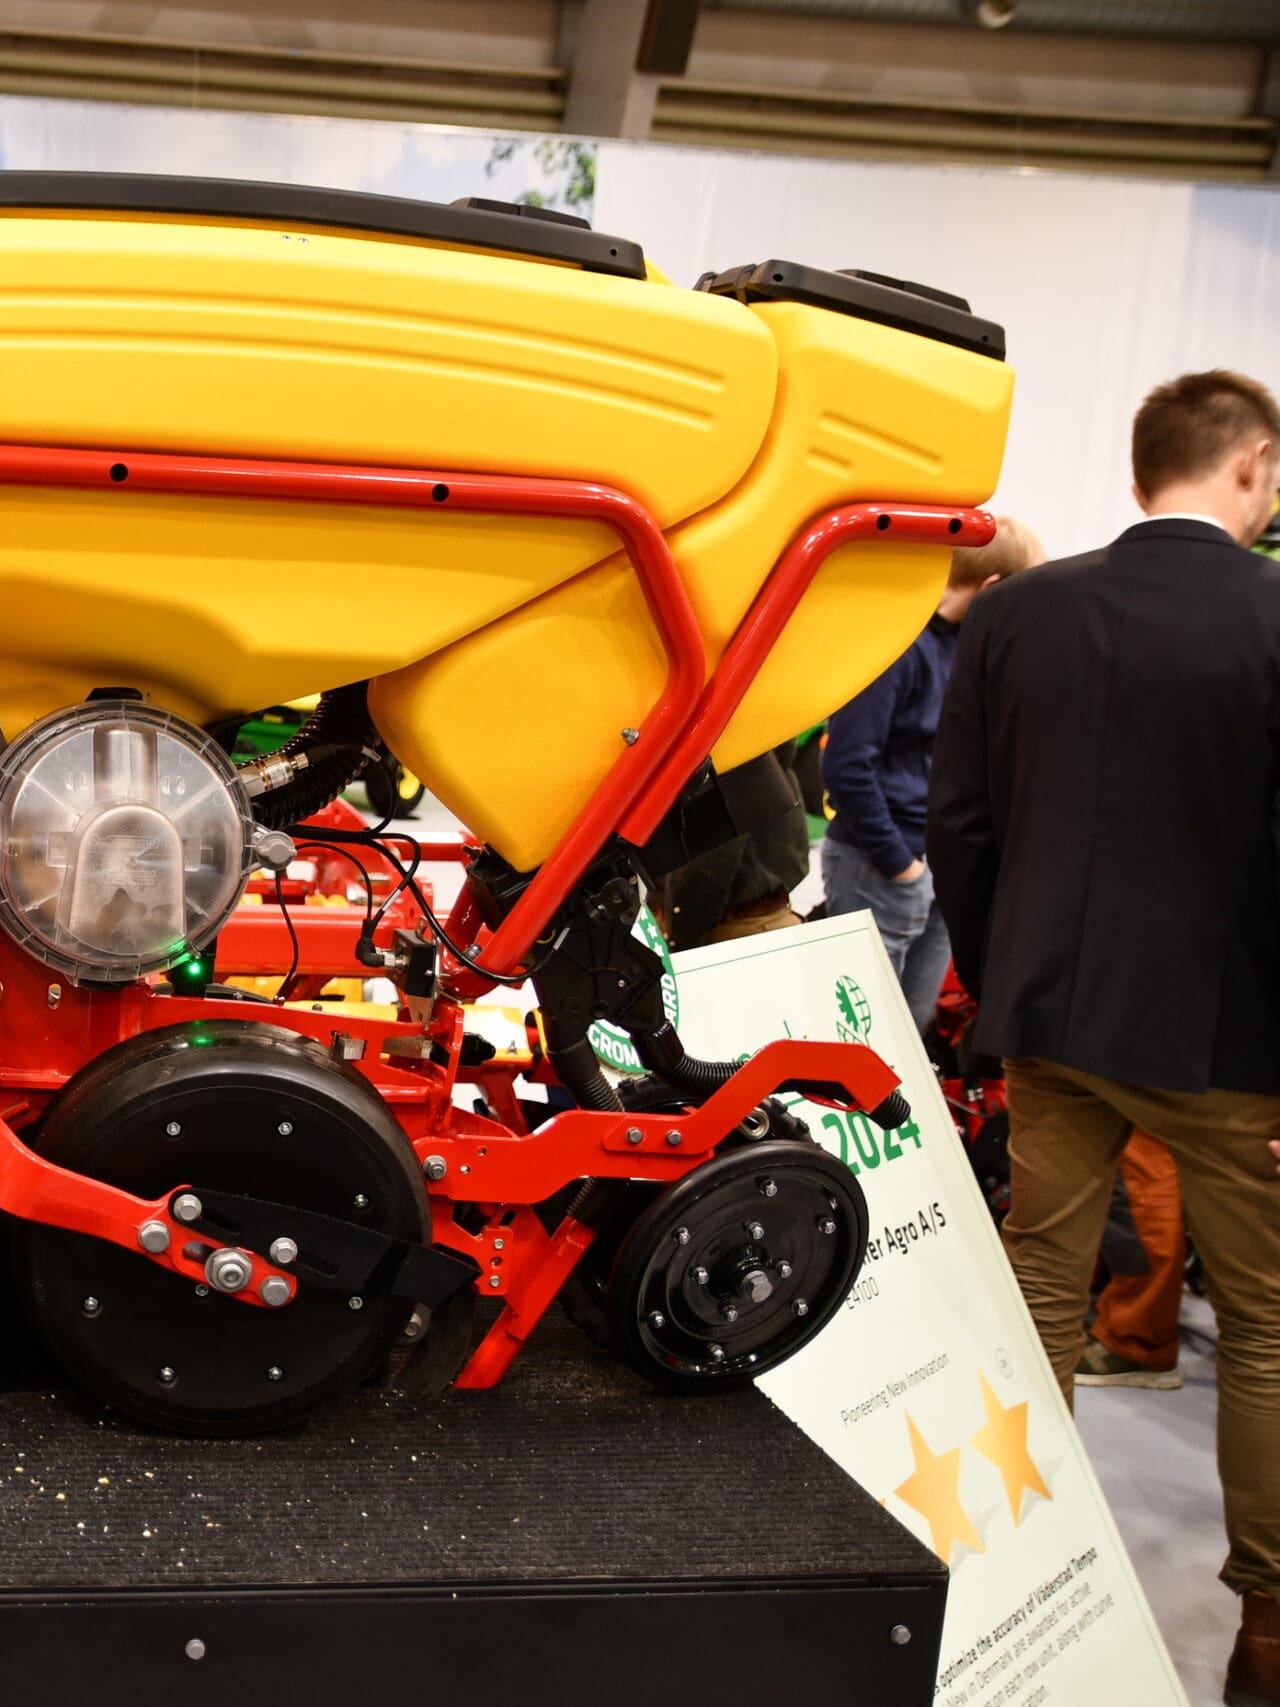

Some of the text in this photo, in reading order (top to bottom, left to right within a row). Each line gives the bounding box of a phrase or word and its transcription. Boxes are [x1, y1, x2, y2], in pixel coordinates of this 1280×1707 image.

[587, 1023, 642, 1068] GROM
[821, 1089, 922, 1176] 2024
[884, 1222, 919, 1255] Agro
[918, 1202, 946, 1236] A/S
[839, 1353, 950, 1428] Pioneering New Innovation
[939, 1648, 979, 1690] optimize
[975, 1636, 994, 1655] the
[992, 1607, 1028, 1643] accuracy
[1025, 1592, 1036, 1614] of
[1070, 1546, 1097, 1574] Tempo
[975, 1648, 1014, 1689] Denmark
[1012, 1638, 1028, 1658] are
[1025, 1609, 1059, 1646] awarded
[1056, 1598, 1070, 1618] for
[1069, 1581, 1092, 1608] active
[1004, 1672, 1024, 1698] each
[1057, 1624, 1081, 1652] along
[1078, 1608, 1095, 1632] with
[1093, 1592, 1114, 1618] curve
